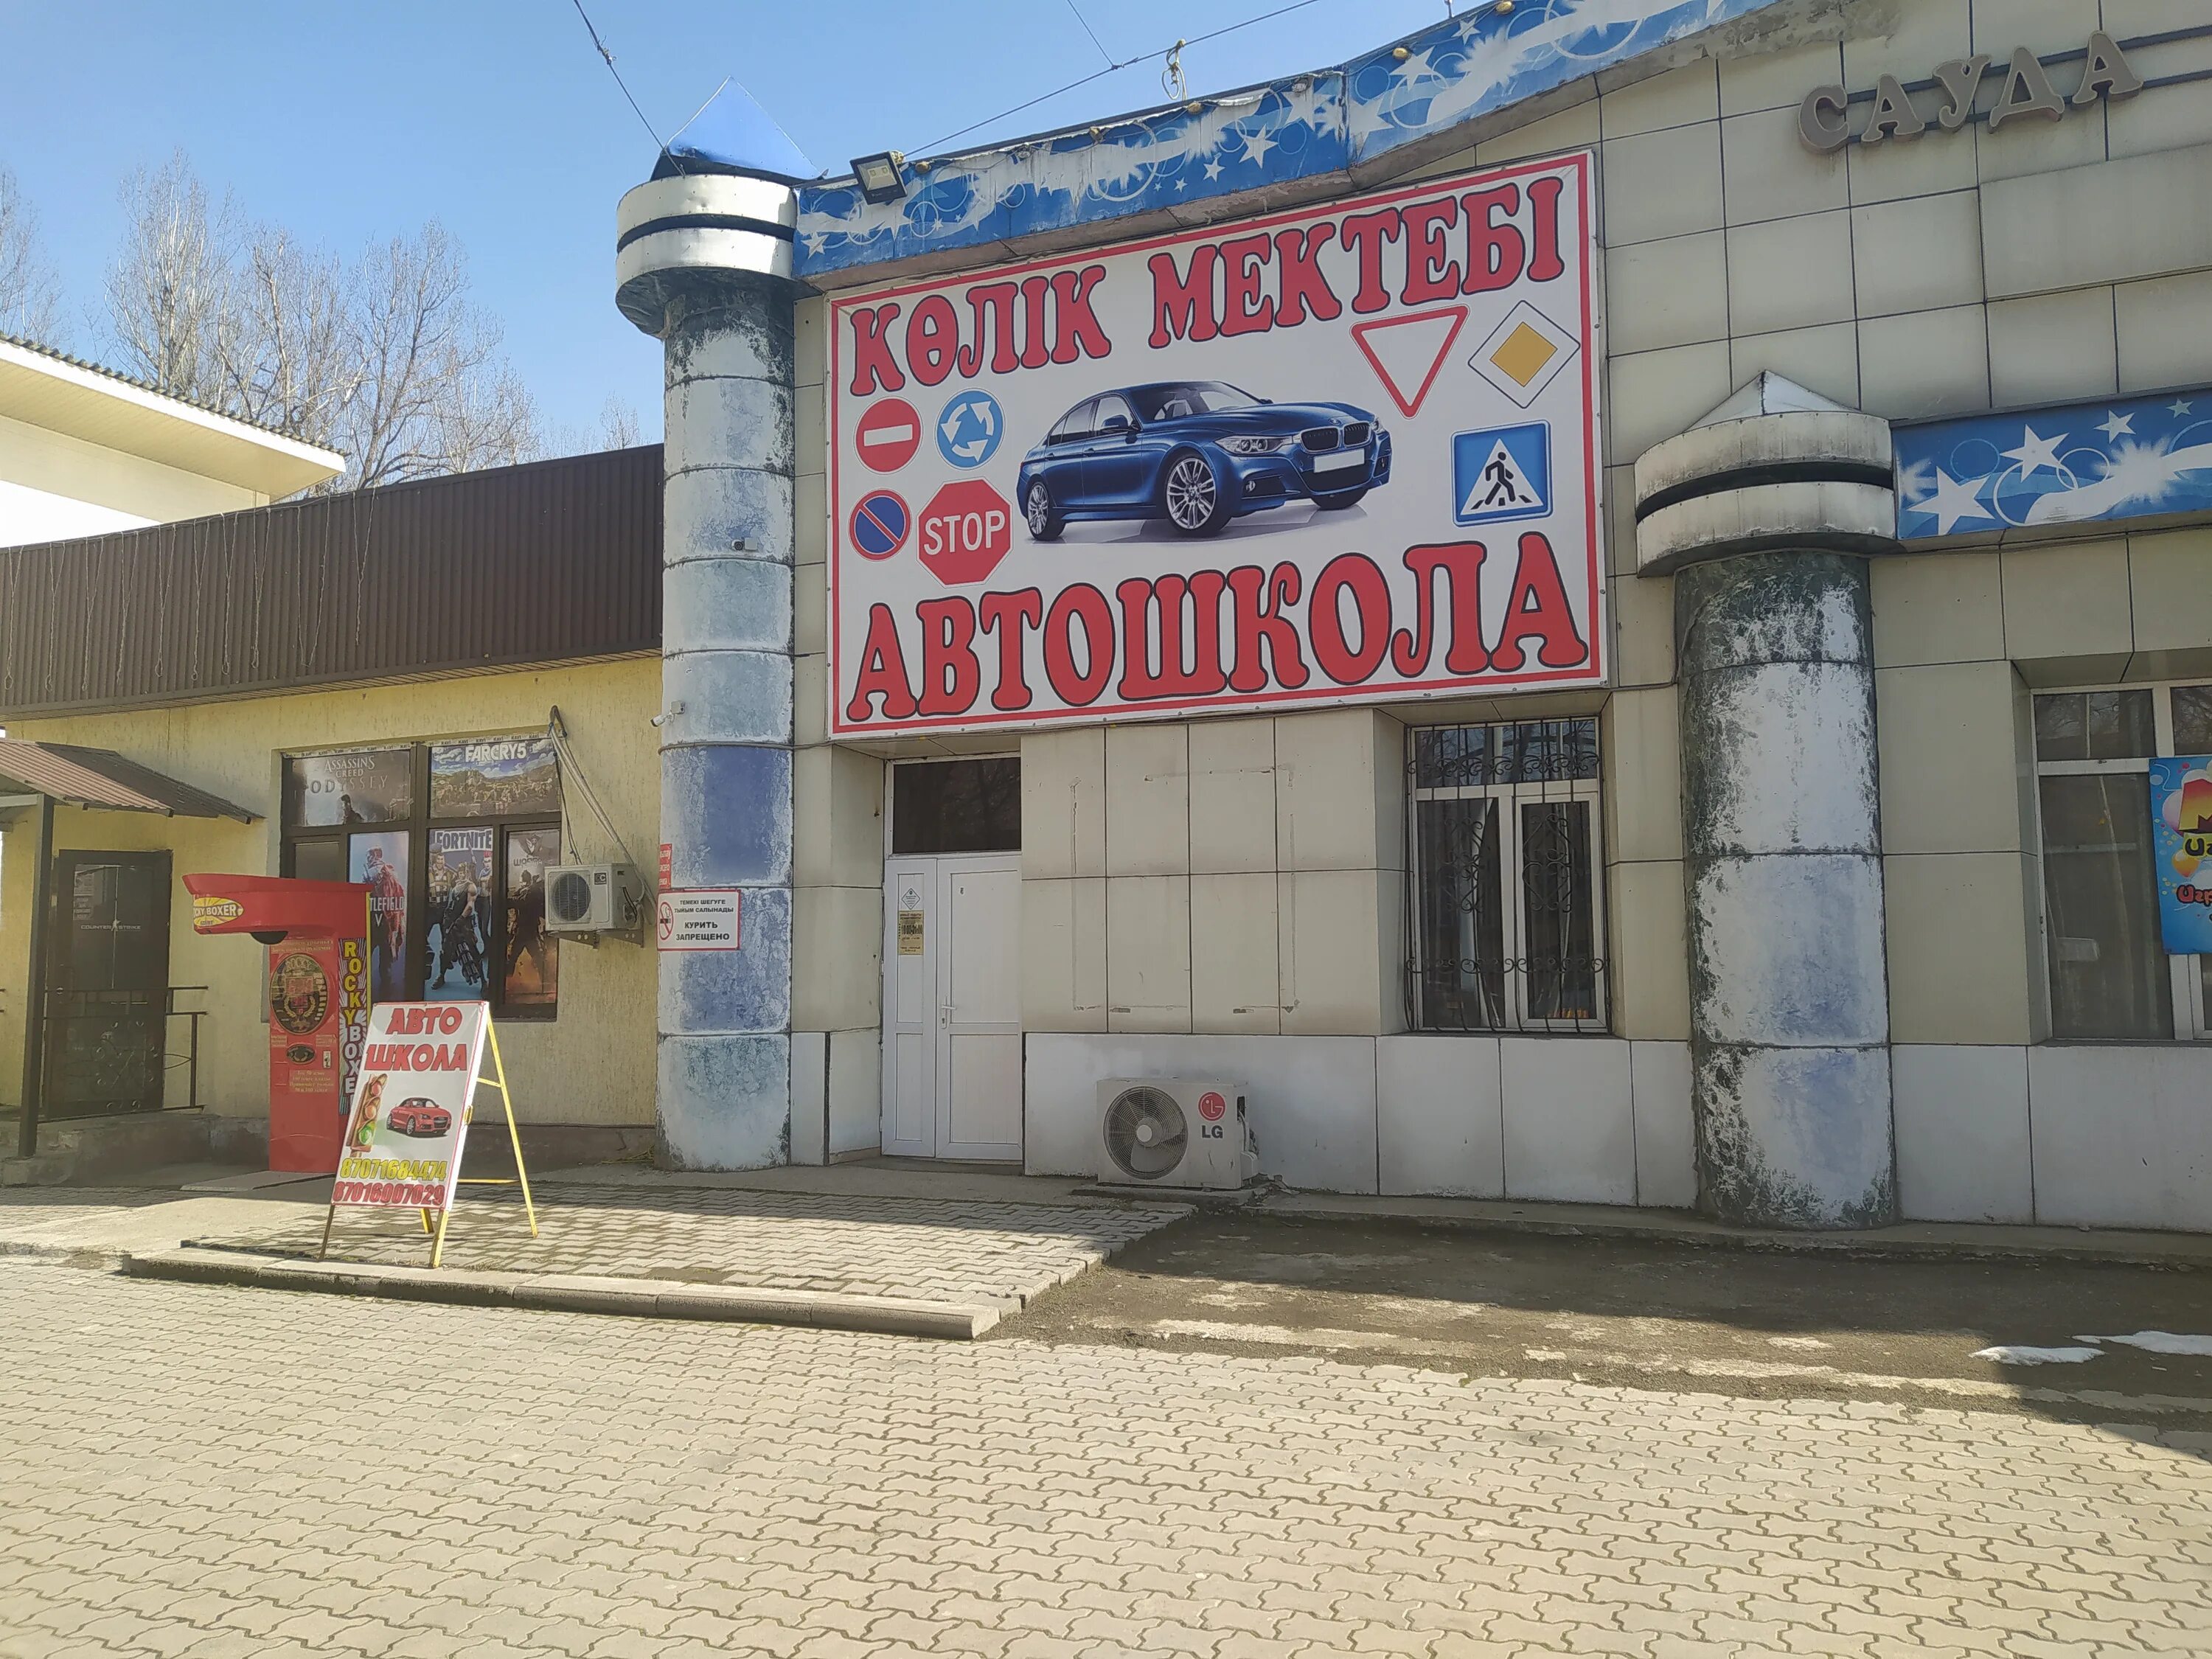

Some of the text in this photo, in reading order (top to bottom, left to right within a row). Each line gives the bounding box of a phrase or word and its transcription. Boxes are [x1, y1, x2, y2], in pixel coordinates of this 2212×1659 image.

[1798, 30, 2143, 154] САУДА
[850, 176, 1565, 397] КӨЛІК МЕКТЕБІ
[924, 505, 1006, 553] STOP
[846, 531, 1588, 722] АВТОШКОЛА
[335, 769, 364, 778] CREED
[437, 831, 493, 849] FORTNITE
[206, 905, 236, 917] BOXER
[375, 914, 383, 927] V
[675, 933, 730, 941] ЗАПРЕЩЕНО
[344, 941, 361, 1025] ROCKY
[385, 1006, 463, 1035] АВТО
[364, 1043, 468, 1071] ШКОЛА
[1202, 1125, 1223, 1138] LG
[340, 1158, 448, 1181] 87071684474
[332, 1181, 445, 1206] 87016007029
